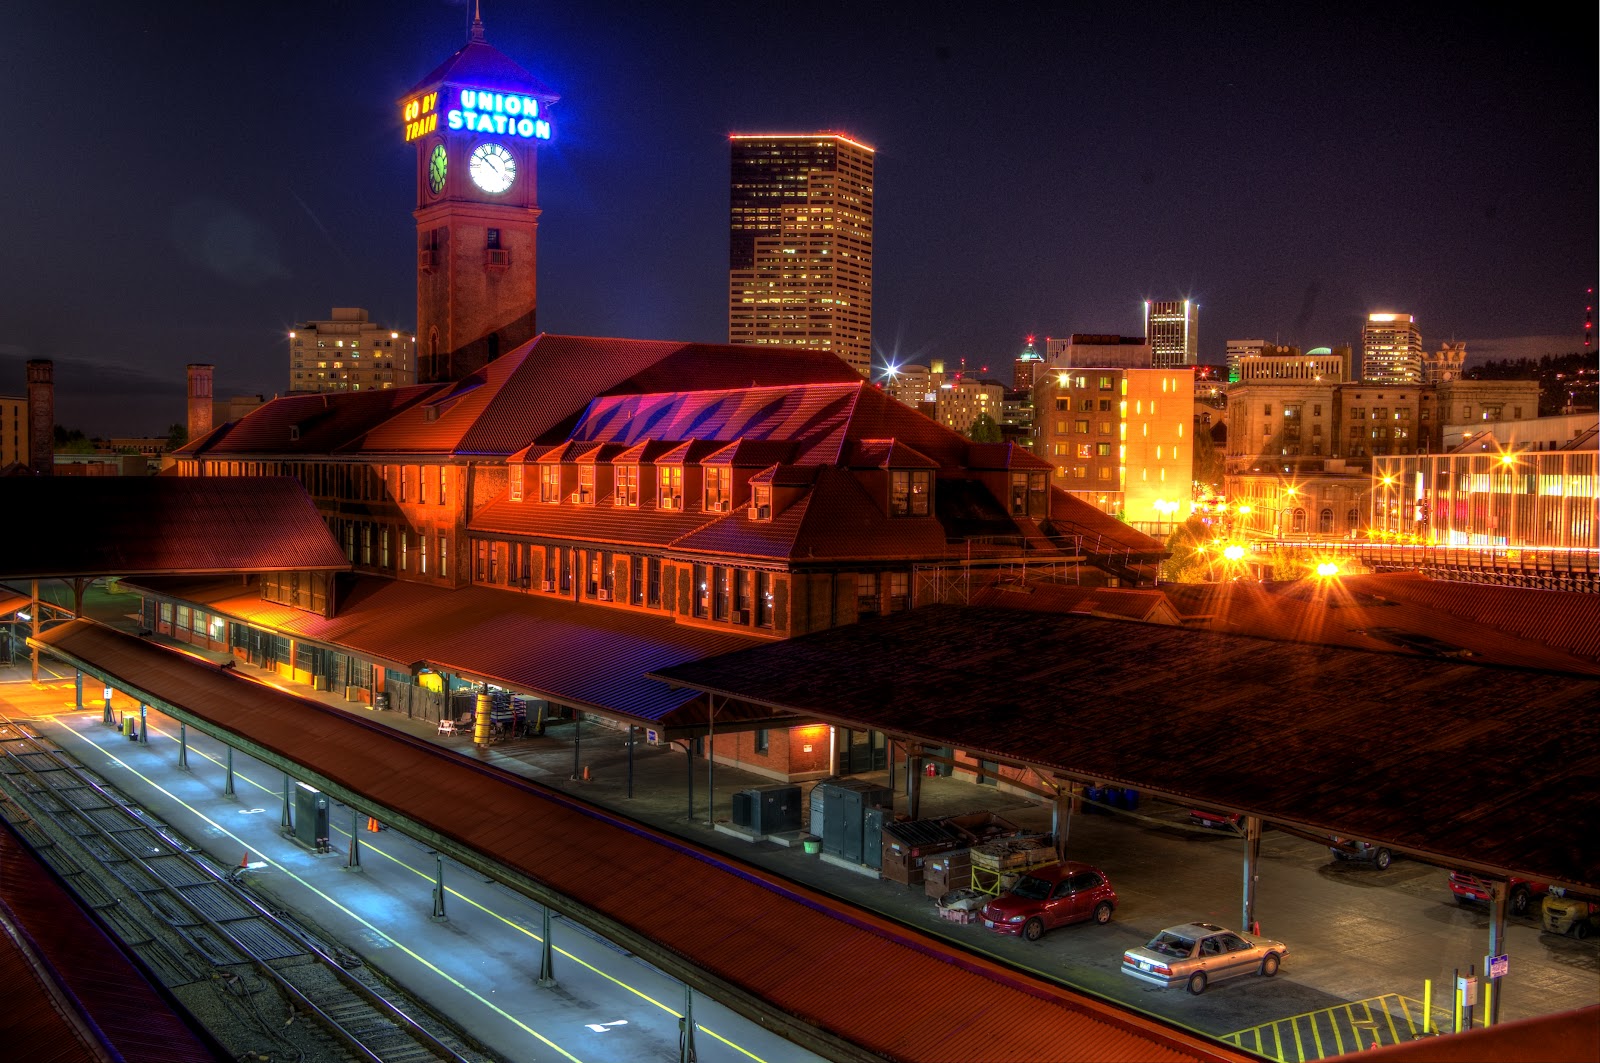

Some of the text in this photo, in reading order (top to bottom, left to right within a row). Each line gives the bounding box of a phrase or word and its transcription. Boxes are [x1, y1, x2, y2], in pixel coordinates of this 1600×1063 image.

[405, 92, 437, 121] GO BY
[460, 89, 538, 117] UNION
[405, 113, 437, 142] TRAIN
[447, 110, 551, 140] STATION
